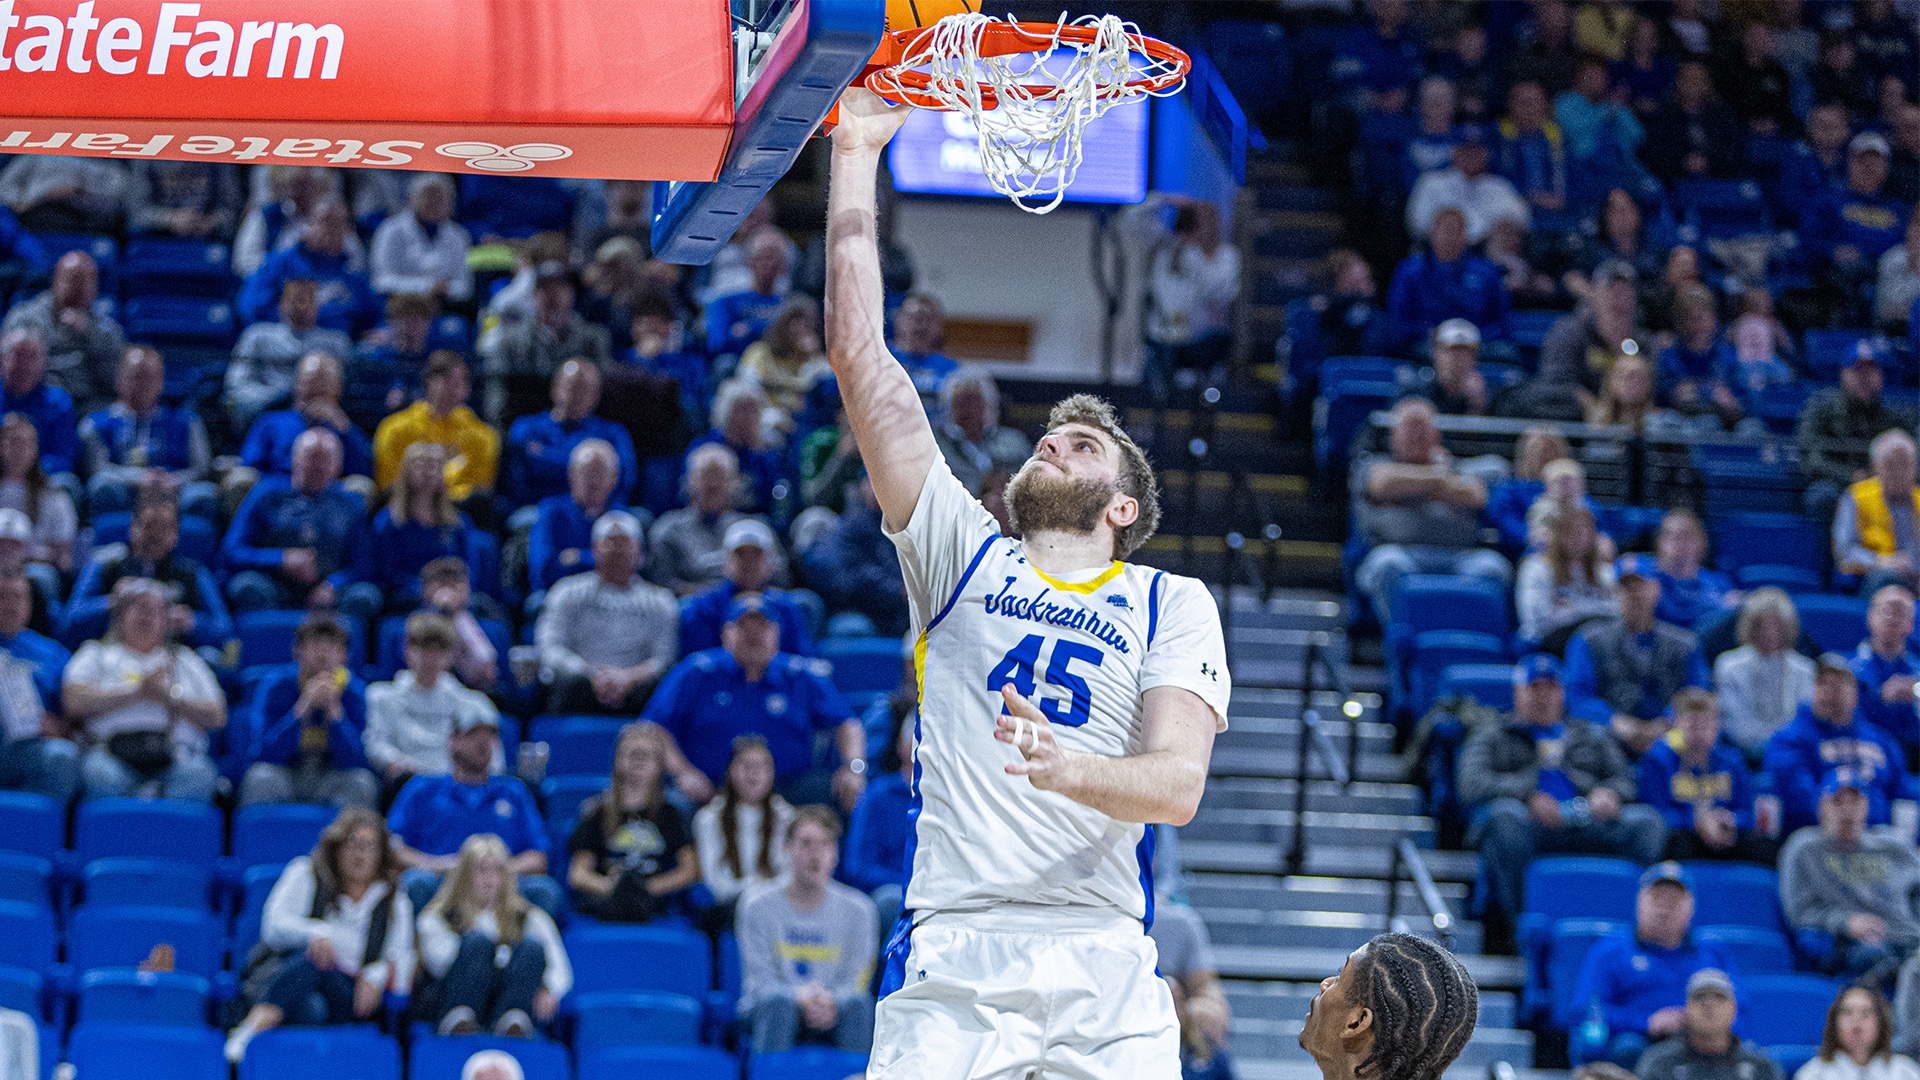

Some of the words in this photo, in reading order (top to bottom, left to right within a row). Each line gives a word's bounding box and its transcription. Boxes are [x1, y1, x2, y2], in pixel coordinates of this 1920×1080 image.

[0, 0, 143, 75] tate
[147, 2, 345, 80] Farm
[180, 135, 425, 165] State
[987, 633, 1105, 728] 45
